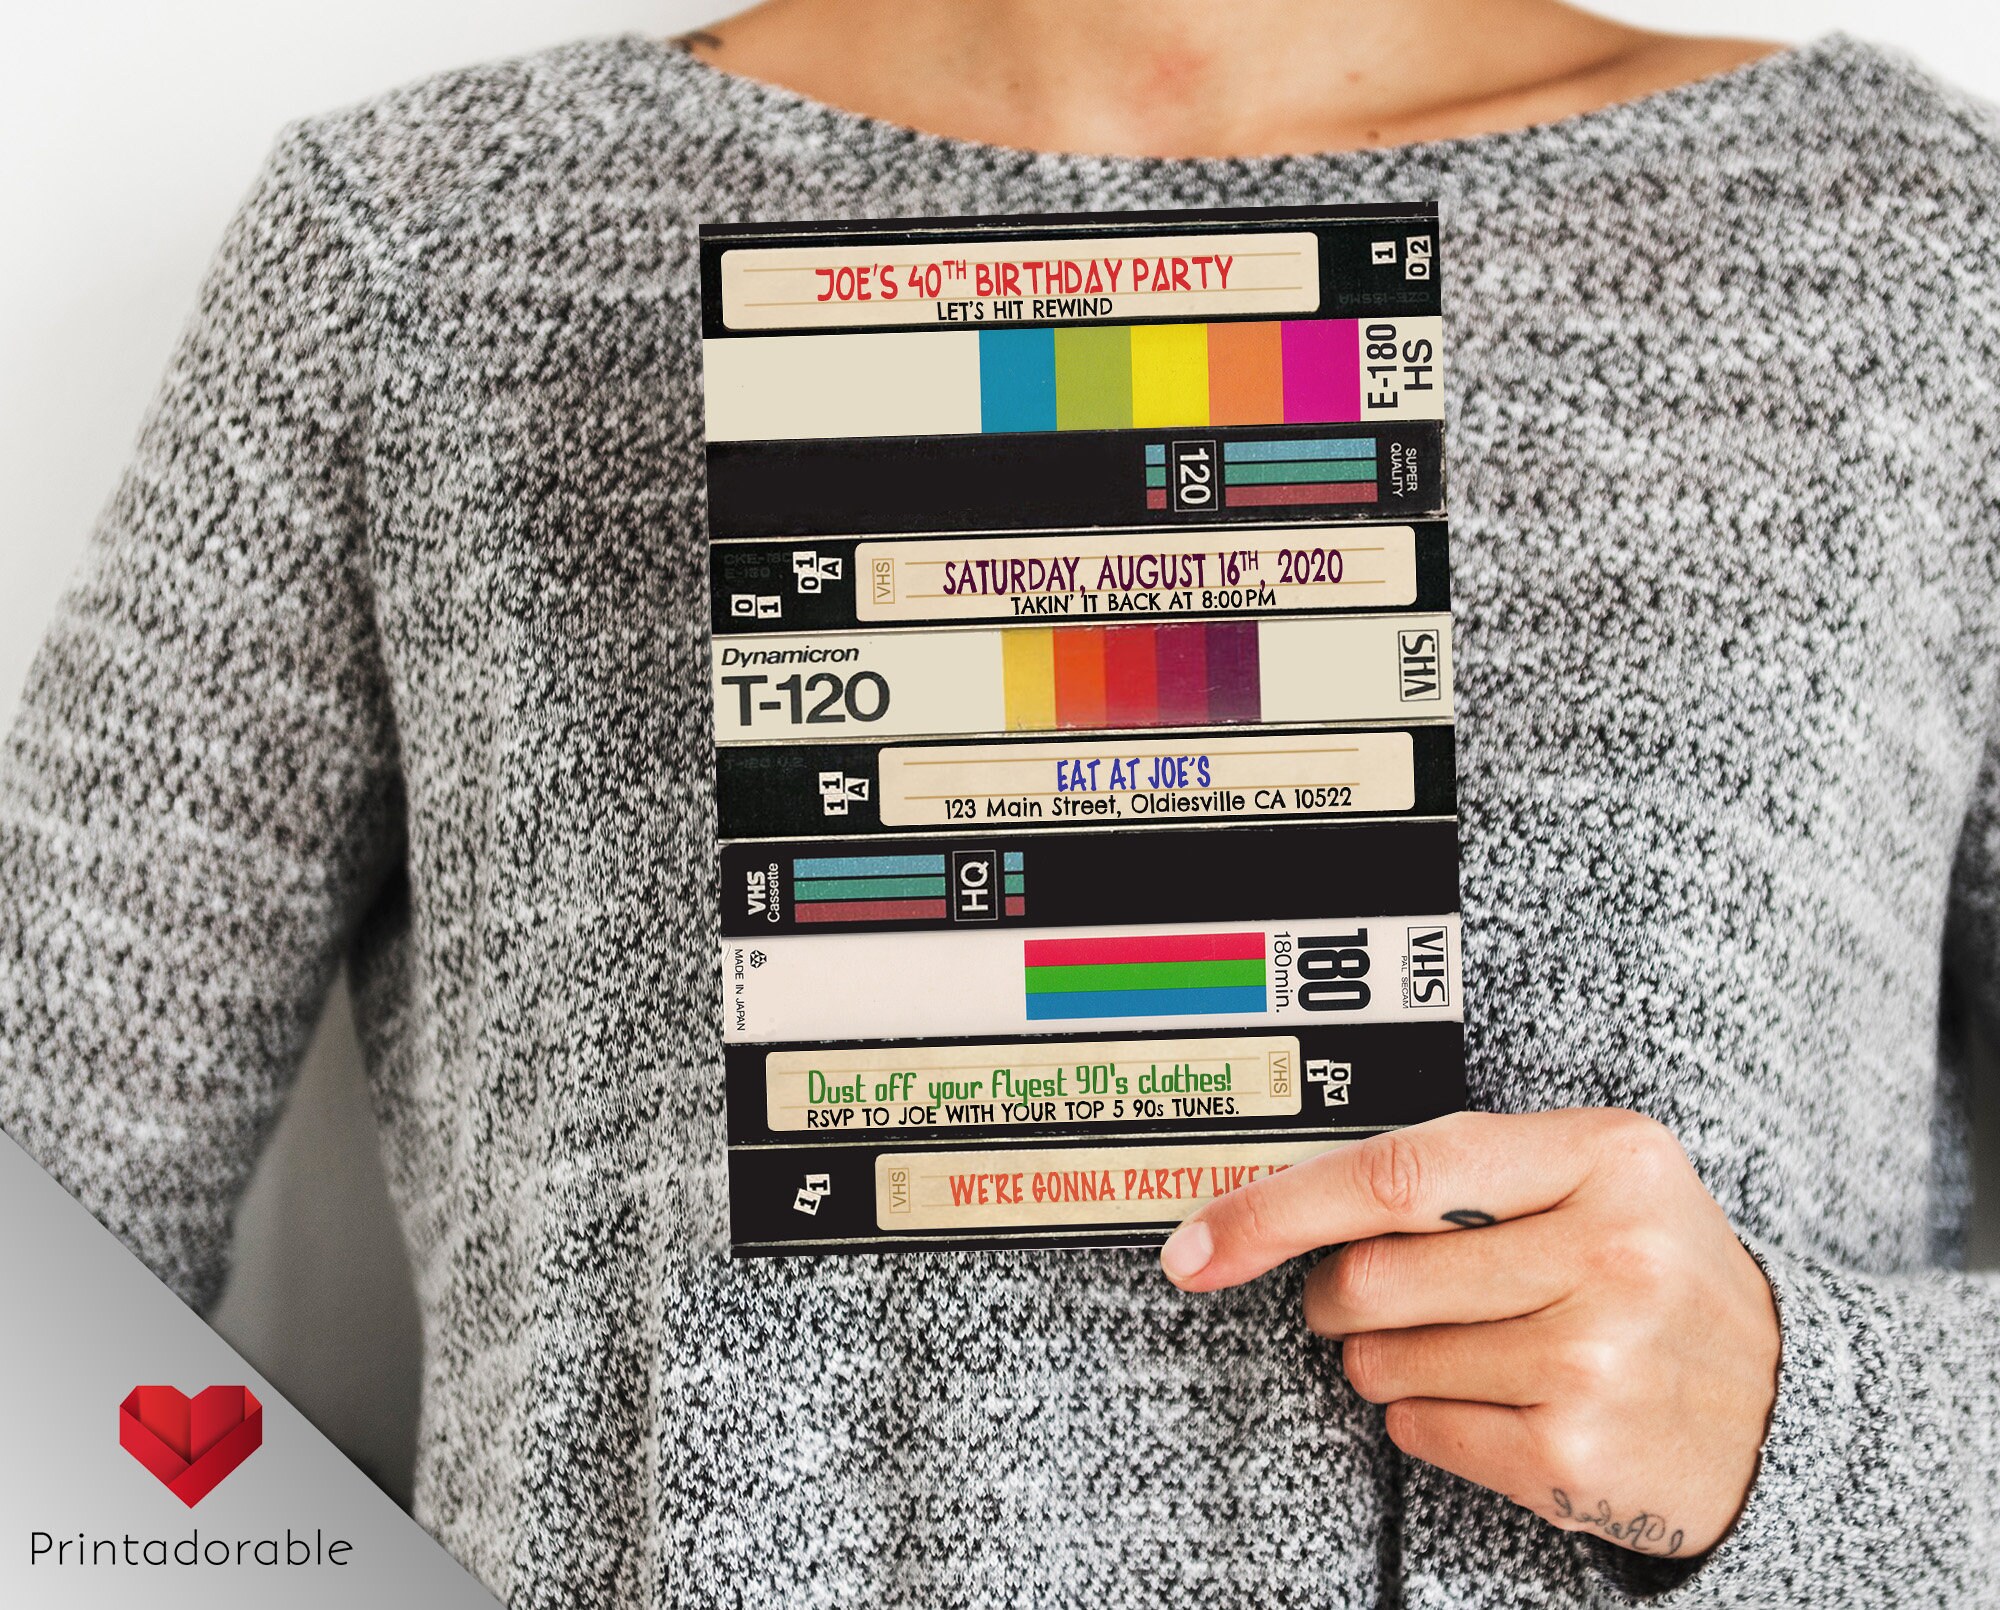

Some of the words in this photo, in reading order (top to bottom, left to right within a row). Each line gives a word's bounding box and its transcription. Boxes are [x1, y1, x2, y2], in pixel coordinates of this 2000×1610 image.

[816, 263, 898, 301] JOE'S
[976, 257, 1122, 297] BIRTHDAY
[1134, 255, 1233, 292] PARTY
[938, 302, 984, 321] LET'S
[994, 301, 1023, 319] HIT
[1033, 297, 1112, 319] REWIND
[1365, 324, 1398, 409] E-180
[1403, 339, 1432, 390] HS
[1180, 448, 1211, 504] 120
[1391, 442, 1403, 498] QUALITY
[1406, 448, 1418, 491] SUPER
[877, 562, 890, 598] VHS
[943, 556, 1087, 596] SATURDAY,
[1097, 554, 1206, 591] AUGUST
[1278, 548, 1343, 584] 2020
[1011, 594, 1074, 616] TAKIN'
[1082, 594, 1098, 612] IT
[1108, 592, 1161, 611] BACK
[1169, 592, 1192, 609] AT
[721, 646, 859, 668] Dynamicron
[1402, 633, 1436, 697] VHS
[721, 671, 890, 726] T-120
[1057, 757, 1100, 792] EAT
[1110, 758, 1140, 790] AT
[1148, 756, 1211, 789] JOE'S
[946, 799, 976, 819] 123
[986, 799, 1042, 818] Main
[1052, 793, 1121, 818] Street,
[1131, 791, 1245, 814] Oldiesville
[1254, 790, 1286, 809] CA
[1295, 788, 1351, 809] 10522
[747, 871, 765, 915] VHS
[767, 863, 780, 922] Cassette
[961, 861, 988, 911] HQ
[735, 949, 743, 979] MADE
[1297, 928, 1371, 1012] 180
[1412, 931, 1446, 1004] VHS
[736, 984, 743, 995] IN
[1401, 977, 1409, 1009] SECAM
[736, 999, 745, 1030] JAPAN
[809, 1070, 866, 1104] Dust
[875, 1073, 917, 1101] off
[929, 1078, 983, 1109] your
[992, 1067, 1067, 1107] flyest
[1076, 1063, 1128, 1094] 90's
[1139, 1063, 1232, 1094] clothes!
[1273, 1057, 1287, 1094] VHS
[808, 1109, 853, 1128] RSVP
[862, 1108, 890, 1126] TO
[898, 1107, 937, 1125] JOE
[945, 1105, 994, 1123] WITH
[1001, 1103, 1055, 1122] YOUR
[1065, 1101, 1104, 1119] TOP
[1113, 1100, 1124, 1118] 5
[1133, 1099, 1163, 1117] 90s
[1172, 1097, 1240, 1117] TUNES.
[892, 1171, 906, 1207] VHS
[950, 1173, 1024, 1206] WE'RE
[1032, 1170, 1115, 1204] GONNA
[1124, 1168, 1204, 1200] PARTY
